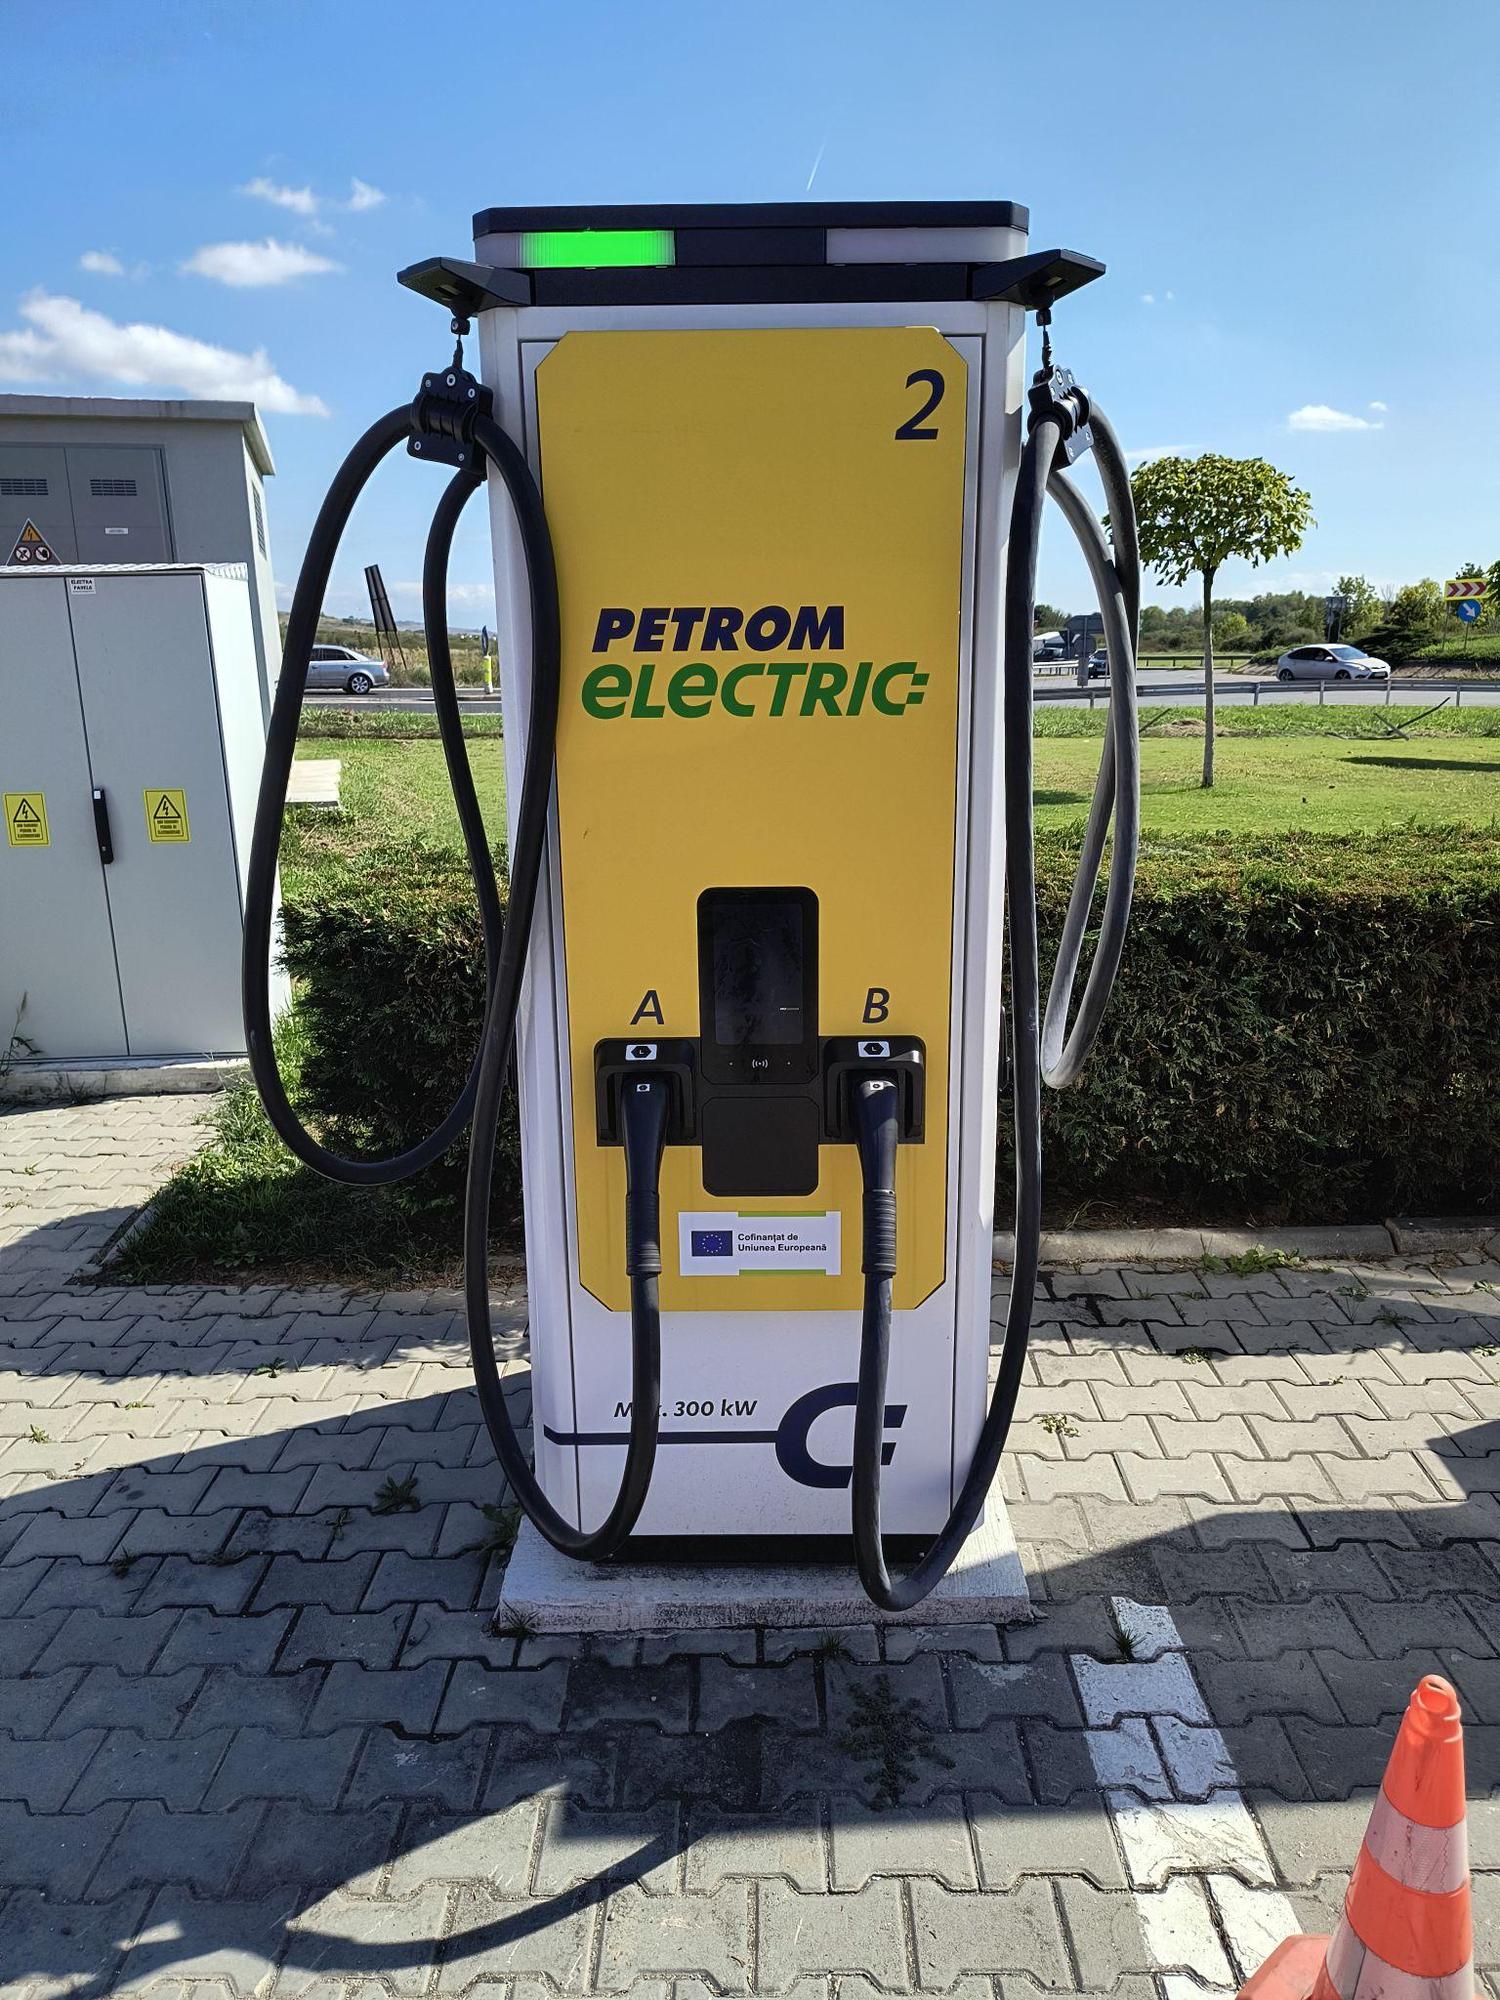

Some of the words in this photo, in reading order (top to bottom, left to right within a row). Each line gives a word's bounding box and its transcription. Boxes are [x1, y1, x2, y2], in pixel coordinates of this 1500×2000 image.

[894, 368, 945, 440] 2
[591, 605, 845, 653] PETROM
[629, 990, 665, 1025] A
[862, 987, 890, 1024] B
[738, 1243, 775, 1251] Uniunea
[777, 1243, 827, 1252] Europeană
[787, 1233, 798, 1241] de
[613, 1402, 668, 1417] M.
[673, 1401, 714, 1417] 300
[721, 1399, 757, 1416] kW
